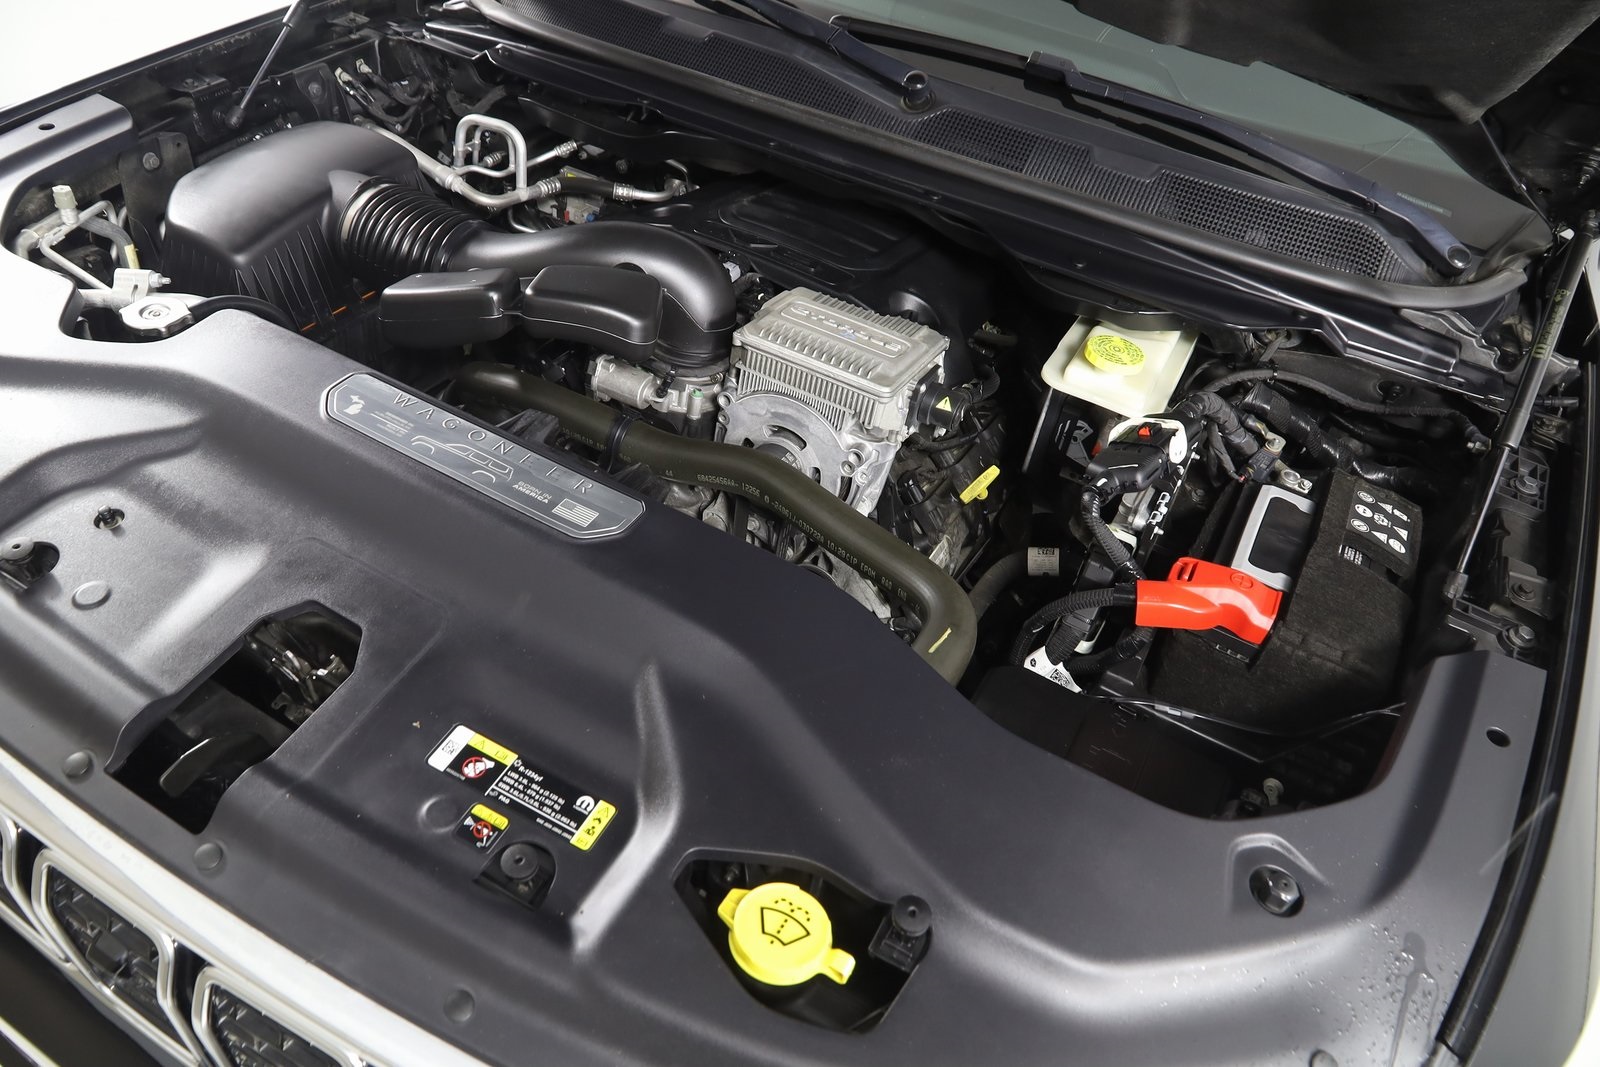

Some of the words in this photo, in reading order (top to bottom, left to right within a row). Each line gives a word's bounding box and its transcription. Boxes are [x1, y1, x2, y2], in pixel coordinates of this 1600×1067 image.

[393, 392, 593, 494] WAGONEER
[512, 484, 549, 504] AMERICA
[517, 480, 542, 495] BORN
[542, 492, 552, 500] IN
